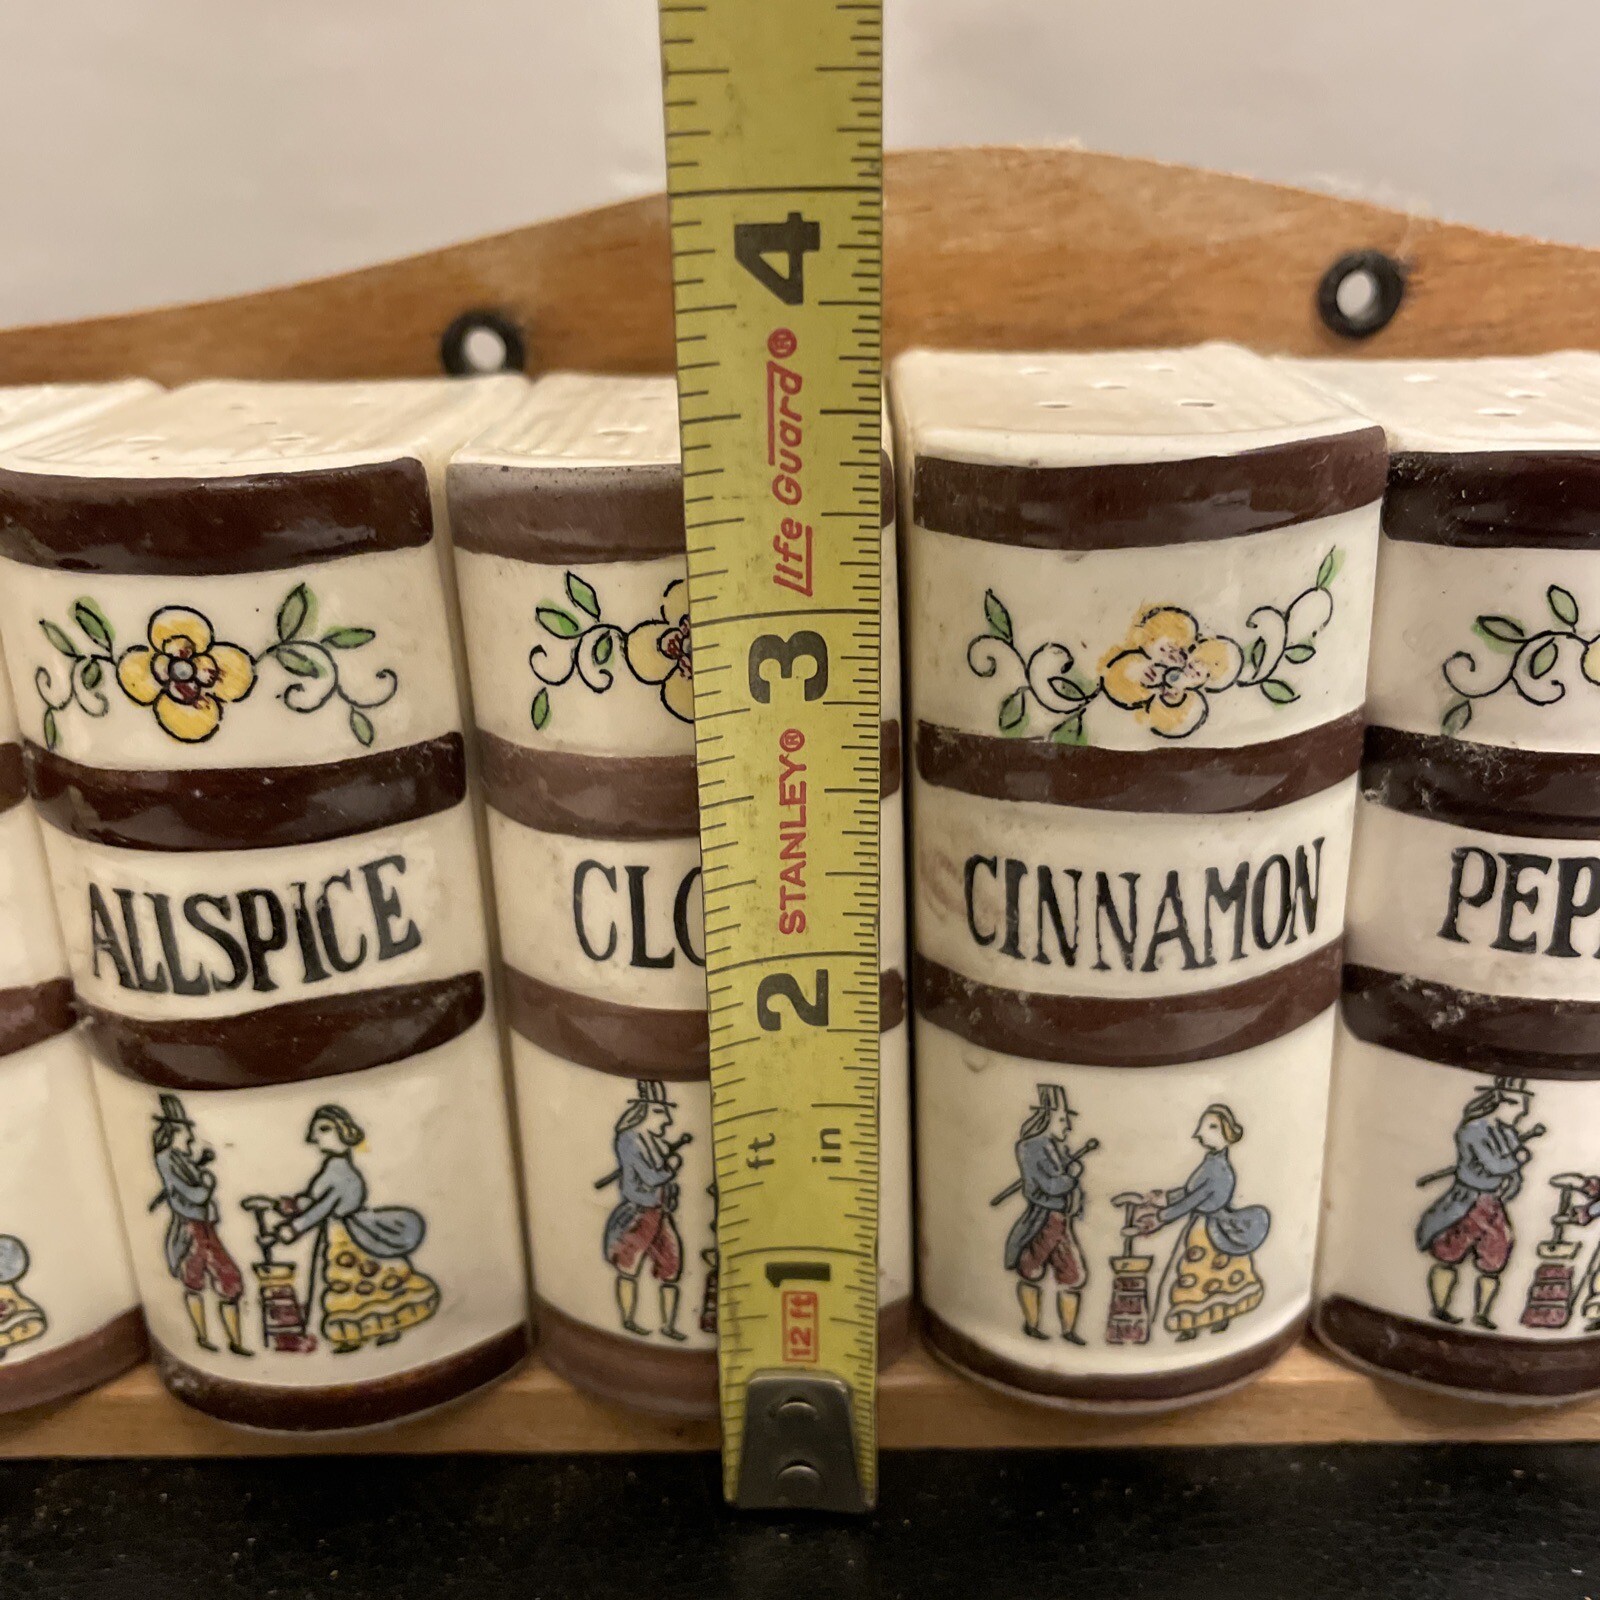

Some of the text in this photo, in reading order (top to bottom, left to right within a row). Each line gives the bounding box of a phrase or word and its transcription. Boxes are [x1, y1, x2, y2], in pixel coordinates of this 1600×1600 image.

[734, 212, 820, 305] 4
[748, 630, 829, 704] 3
[89, 854, 423, 996] ALLSPICE
[963, 837, 1326, 973] CINNAMON
[1436, 846, 1600, 960] PEP
[756, 968, 829, 1032] 2
[746, 1132, 777, 1170] ft
[811, 1127, 842, 1164] in
[765, 1261, 832, 1288] 1
